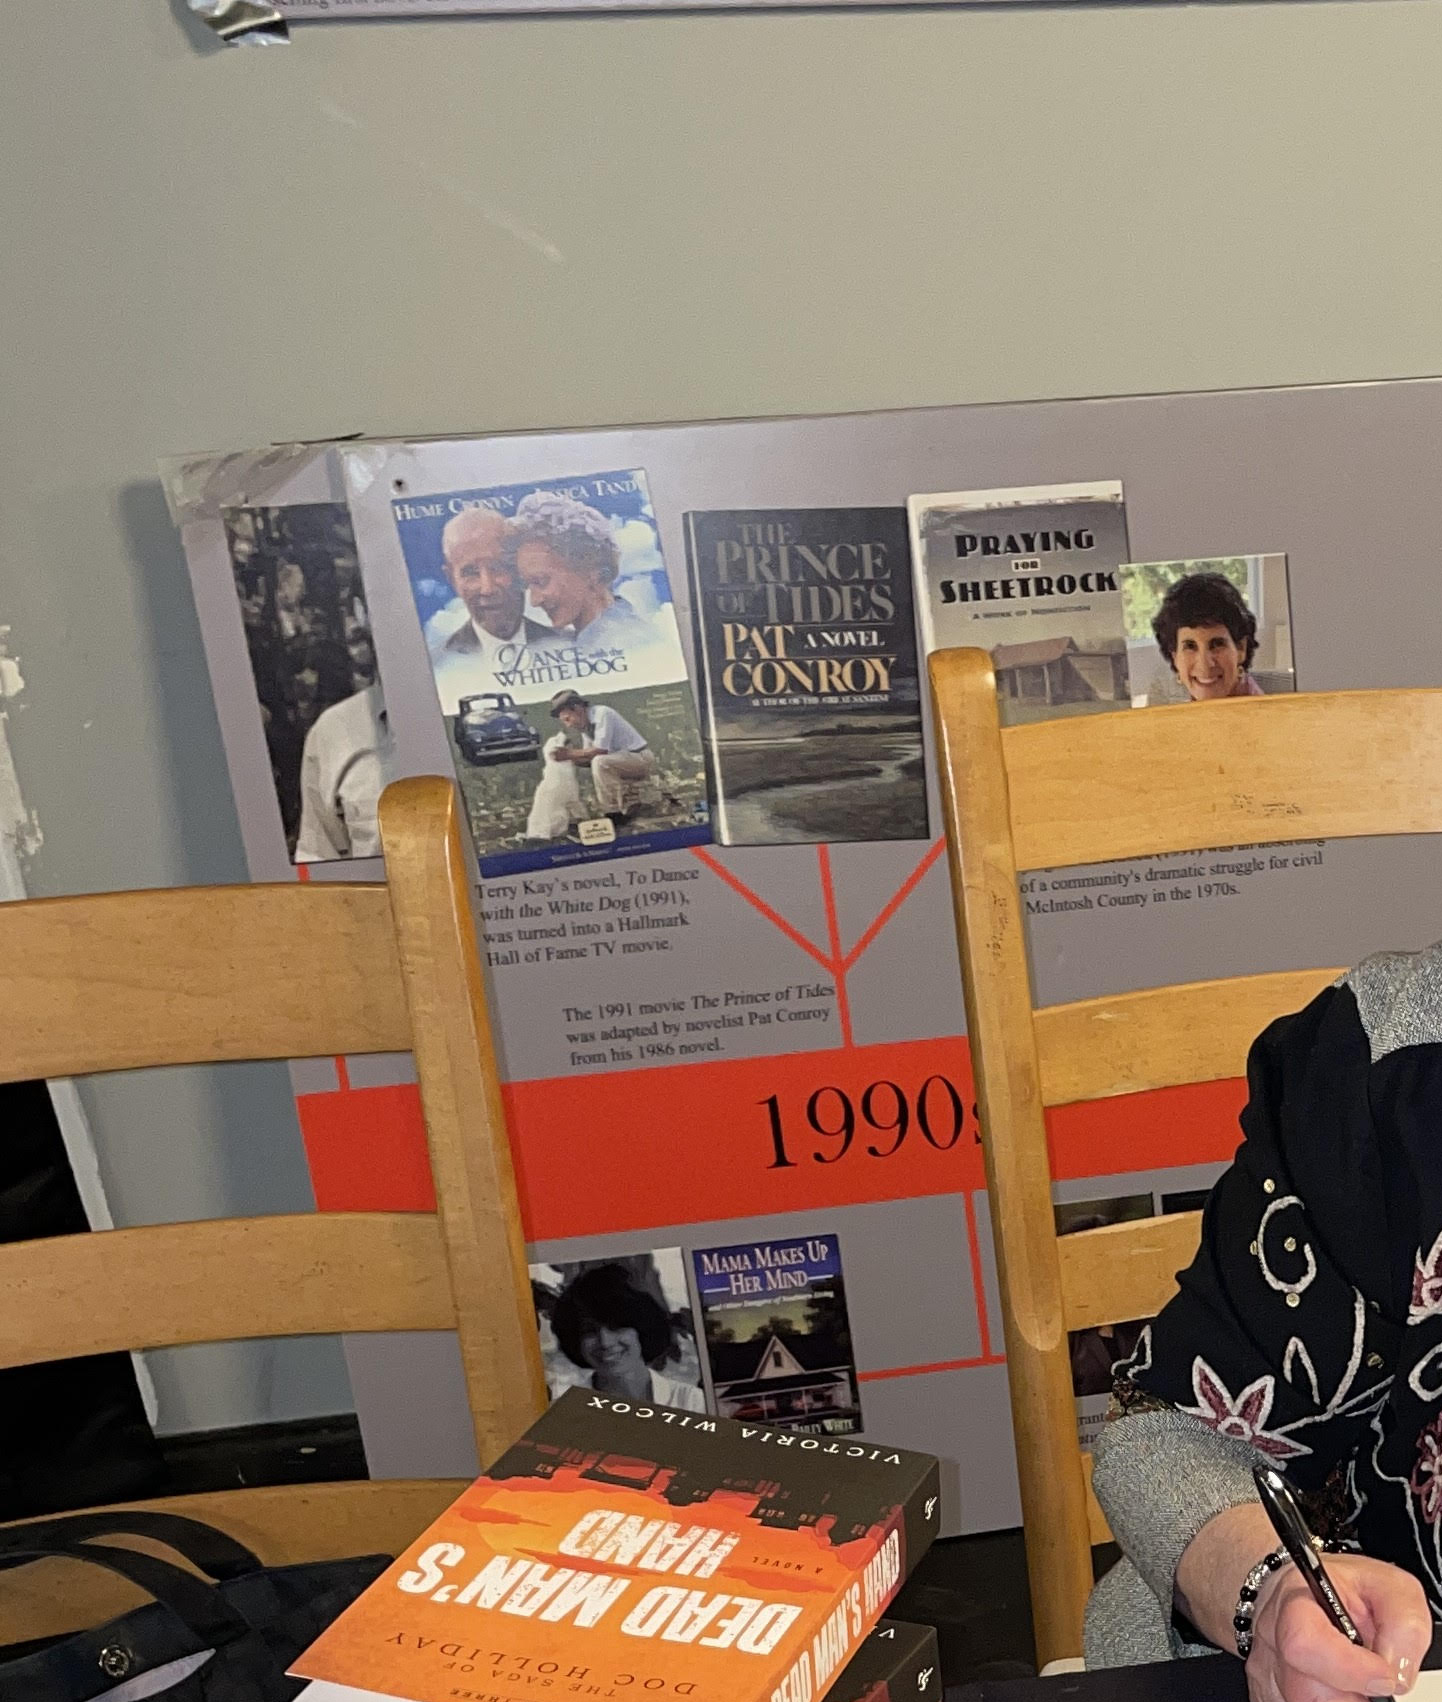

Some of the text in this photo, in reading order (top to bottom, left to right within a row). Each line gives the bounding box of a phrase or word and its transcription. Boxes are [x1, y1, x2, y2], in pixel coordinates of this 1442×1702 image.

[739, 522, 793, 545] THE
[955, 528, 1094, 557] PRAYING
[716, 539, 891, 583] PRINCE
[1015, 562, 1039, 570] FOR
[752, 583, 895, 623] TIDES
[940, 571, 1118, 603] SHEETROCK
[722, 623, 795, 660] PAT
[805, 630, 885, 648] A NOVEL
[494, 656, 627, 687] WHITE DOG
[497, 643, 584, 671] DANCE
[722, 658, 897, 696] CONROY
[475, 884, 517, 899] Terry
[574, 875, 621, 892] novel,
[626, 871, 647, 885] To
[652, 868, 699, 883] Dance
[1020, 880, 1037, 893] of
[1039, 881, 1047, 891] a
[1051, 871, 1141, 890] community's
[1145, 864, 1205, 881] dramatic
[1210, 859, 1264, 878] struggle
[1269, 855, 1288, 869] for
[1293, 851, 1322, 866] civil
[481, 906, 515, 921] with
[519, 904, 542, 918] the
[547, 899, 594, 916] White
[599, 896, 631, 913] Dog
[1027, 882, 1240, 914] McIntosh County in the 1970s.
[484, 913, 690, 943] was turned into a Hallmark
[488, 938, 673, 966] Hall of Fame TV movie.
[563, 984, 835, 1022] The 1991 movie The Prince of Tides
[567, 1007, 831, 1043] was adapted by novelist Pat Conroy
[571, 1038, 724, 1066] from his 1986 novel.
[586, 1395, 902, 1466] VICTORIA WILCOX
[559, 1509, 743, 1578] HAND
[396, 1542, 803, 1656] DEAD MAN'S
[813, 1582, 861, 1691] MAN'S
[864, 1529, 899, 1617] HAND
[384, 1632, 698, 1696] DOC HOLLIDAY
[443, 1660, 617, 1697] THE SAGA OF
